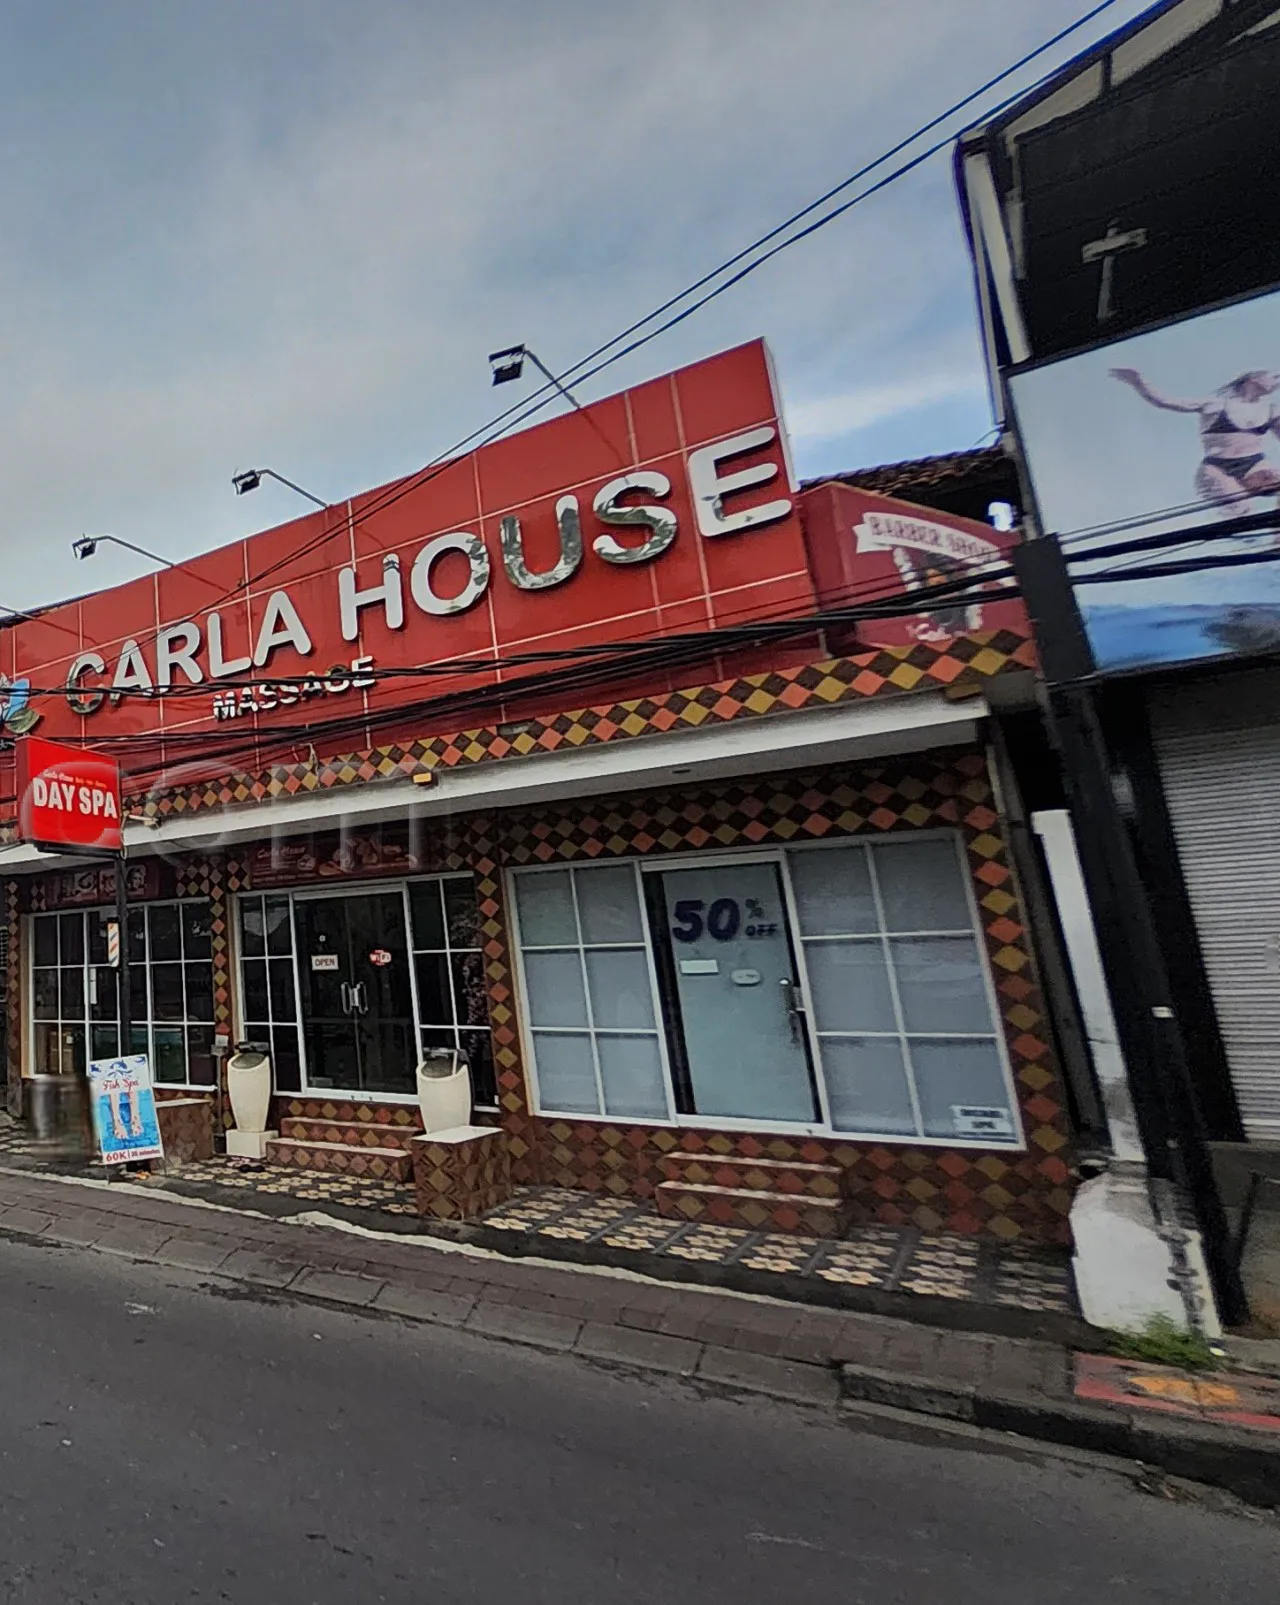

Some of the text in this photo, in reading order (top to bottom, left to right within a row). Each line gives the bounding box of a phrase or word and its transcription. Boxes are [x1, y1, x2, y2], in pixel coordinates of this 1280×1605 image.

[66, 426, 792, 713] CARLA HOUSE
[213, 655, 376, 720] MASSAGE
[32, 777, 118, 819] DAY SPA
[315, 958, 335, 967] OPEN
[102, 1078, 139, 1092] Fish Spa
[106, 1150, 127, 1161] 60K
